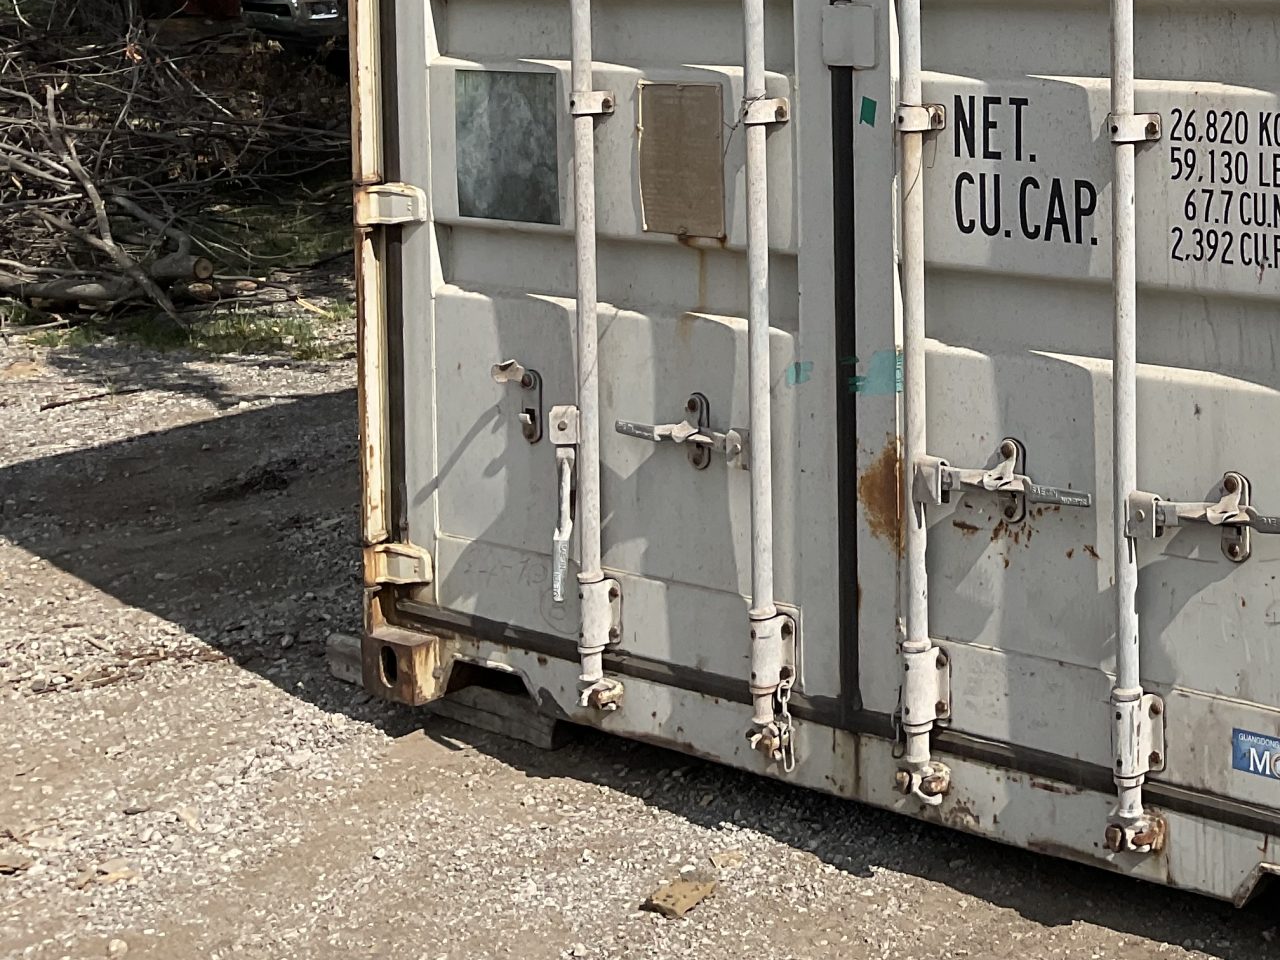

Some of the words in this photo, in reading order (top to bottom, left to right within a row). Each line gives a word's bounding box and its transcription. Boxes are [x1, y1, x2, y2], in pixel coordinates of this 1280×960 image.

[954, 94, 1037, 162] NET.
[1170, 108, 1248, 144] 26,820
[1171, 146, 1248, 185] 59,130
[954, 172, 1098, 246] CU.CAP.
[1184, 188, 1234, 224] 67.7
[1171, 227, 1234, 265] 2,392
[1238, 732, 1280, 750] GUANGDONG
